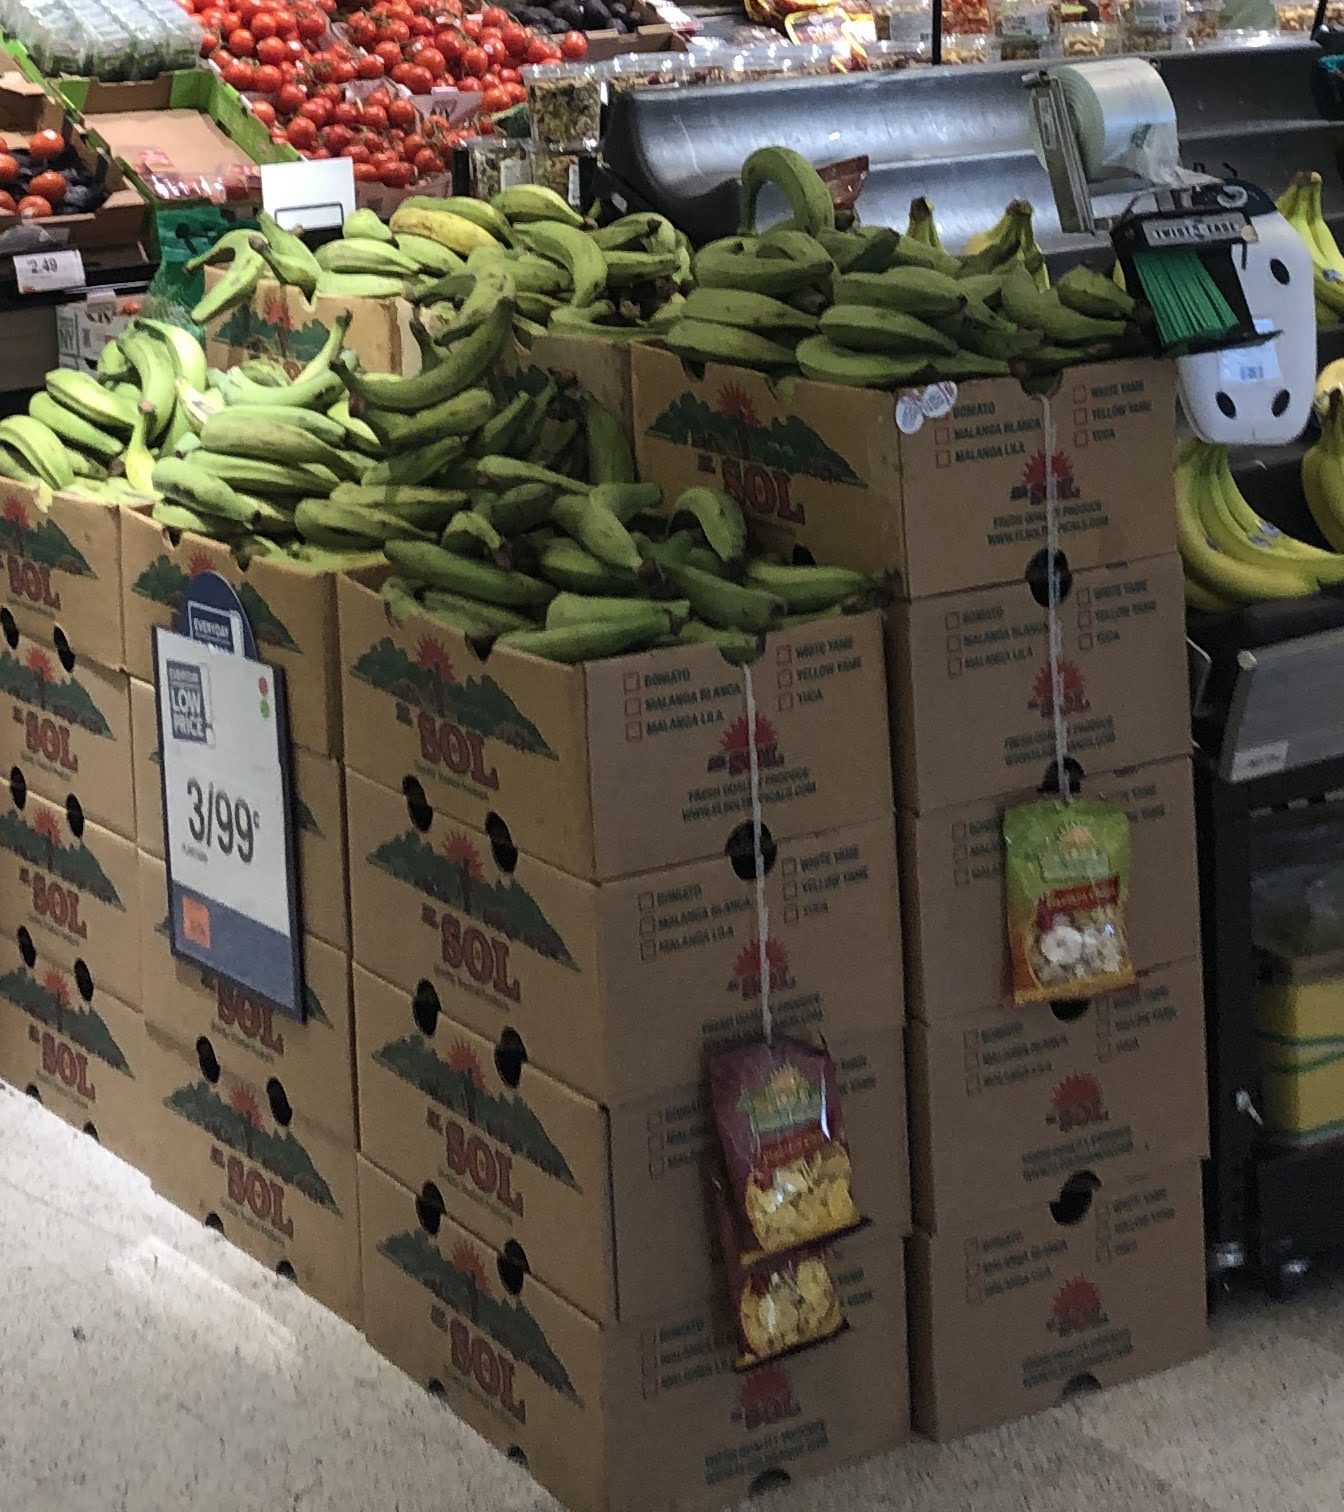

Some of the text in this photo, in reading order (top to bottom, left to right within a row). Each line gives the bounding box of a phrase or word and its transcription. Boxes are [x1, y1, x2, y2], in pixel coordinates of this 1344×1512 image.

[171, 688, 202, 714] LOW
[173, 711, 206, 738] PRICE
[25, 711, 78, 773] SOL
[417, 710, 500, 792] SOL
[32, 872, 87, 942] SOL
[440, 913, 522, 1003] SOL
[41, 1030, 96, 1103] SOL
[226, 1154, 295, 1241] SOL
[445, 1120, 524, 1218] SOL
[449, 1316, 527, 1426] SOL
